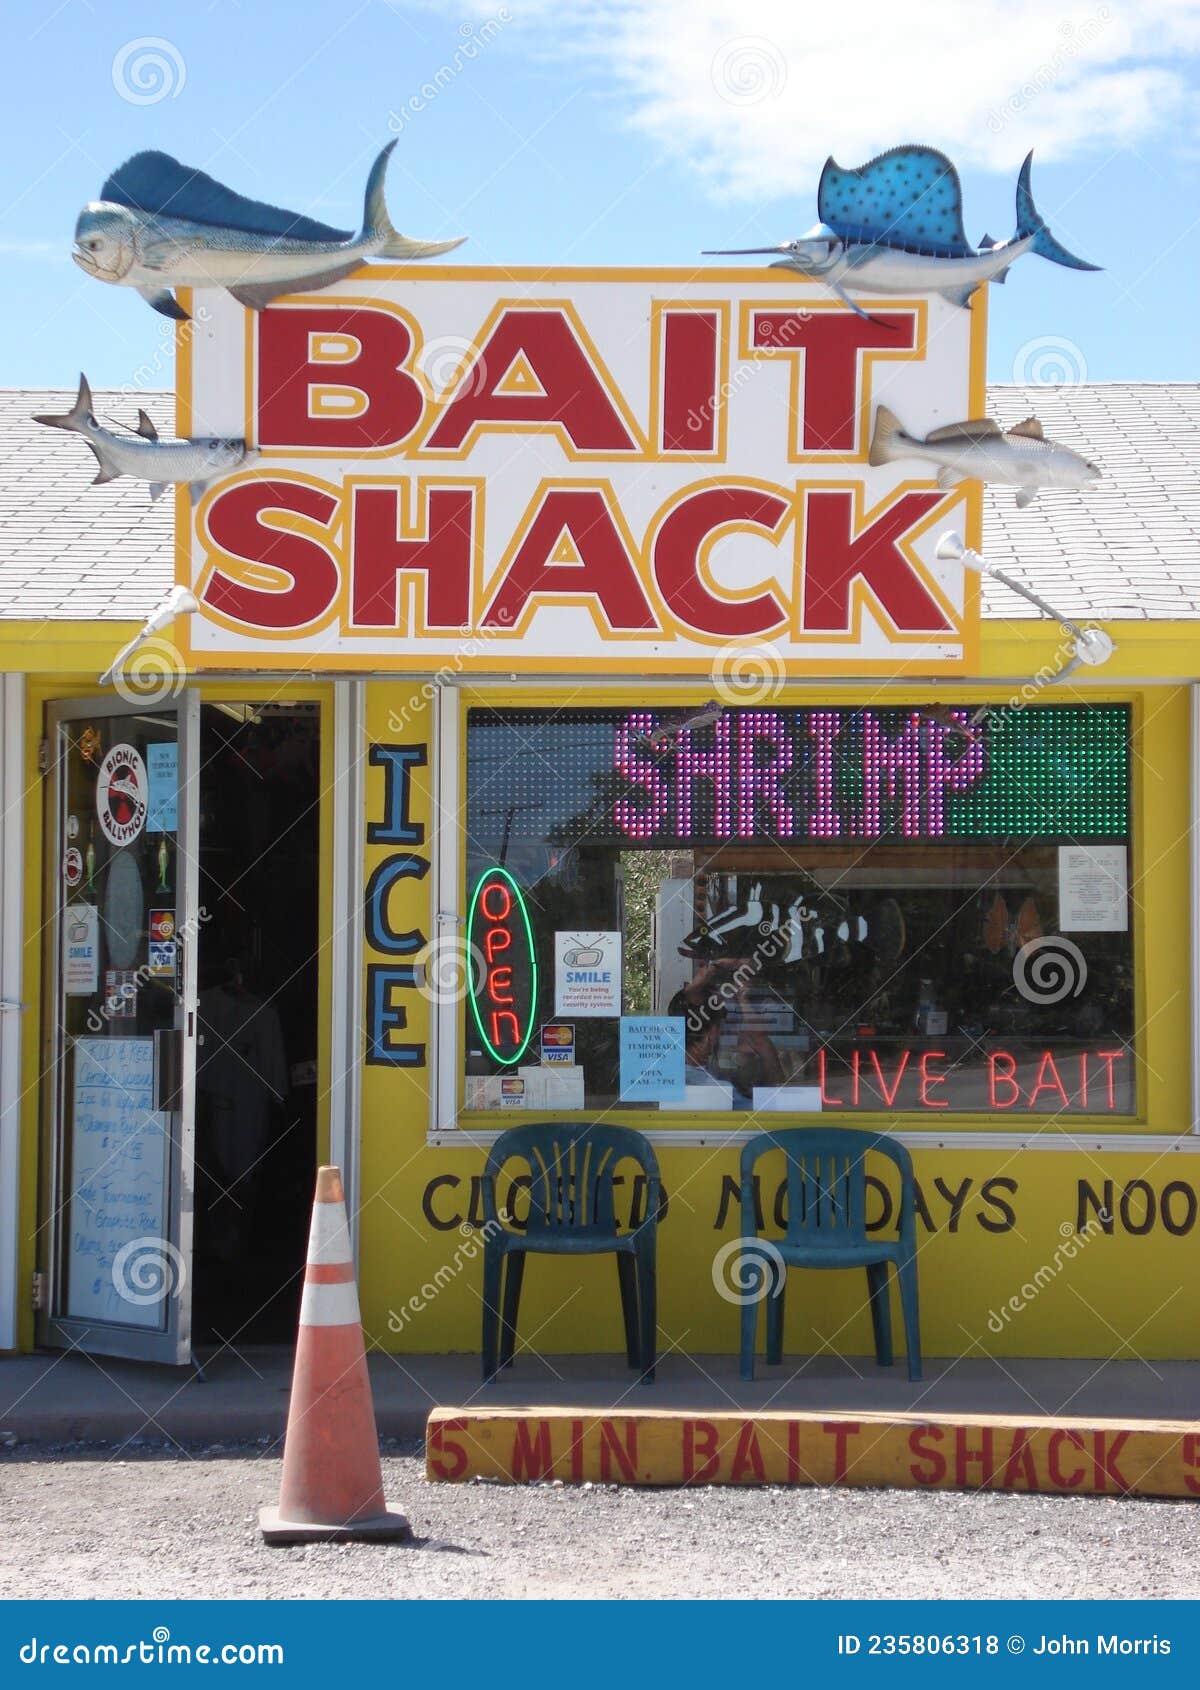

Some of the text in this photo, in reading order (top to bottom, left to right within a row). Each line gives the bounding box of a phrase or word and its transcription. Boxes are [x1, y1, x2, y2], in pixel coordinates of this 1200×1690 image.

[254, 303, 920, 454] BAIT
[198, 478, 958, 638] SHACK
[106, 750, 139, 774] BIONIC
[614, 711, 985, 838] SHRIMP
[102, 801, 146, 841] BALLYHOO
[364, 743, 431, 1067] ICE
[566, 971, 612, 983] SMILE
[547, 1053, 569, 1061] VISA
[818, 1047, 1124, 1109] LIVE BAIT
[713, 1174, 1019, 1234] MDAYS
[1076, 1178, 1198, 1237] NOO
[430, 1417, 469, 1479] 5
[681, 1419, 860, 1484] BAIT
[907, 1424, 1139, 1493] SHACK
